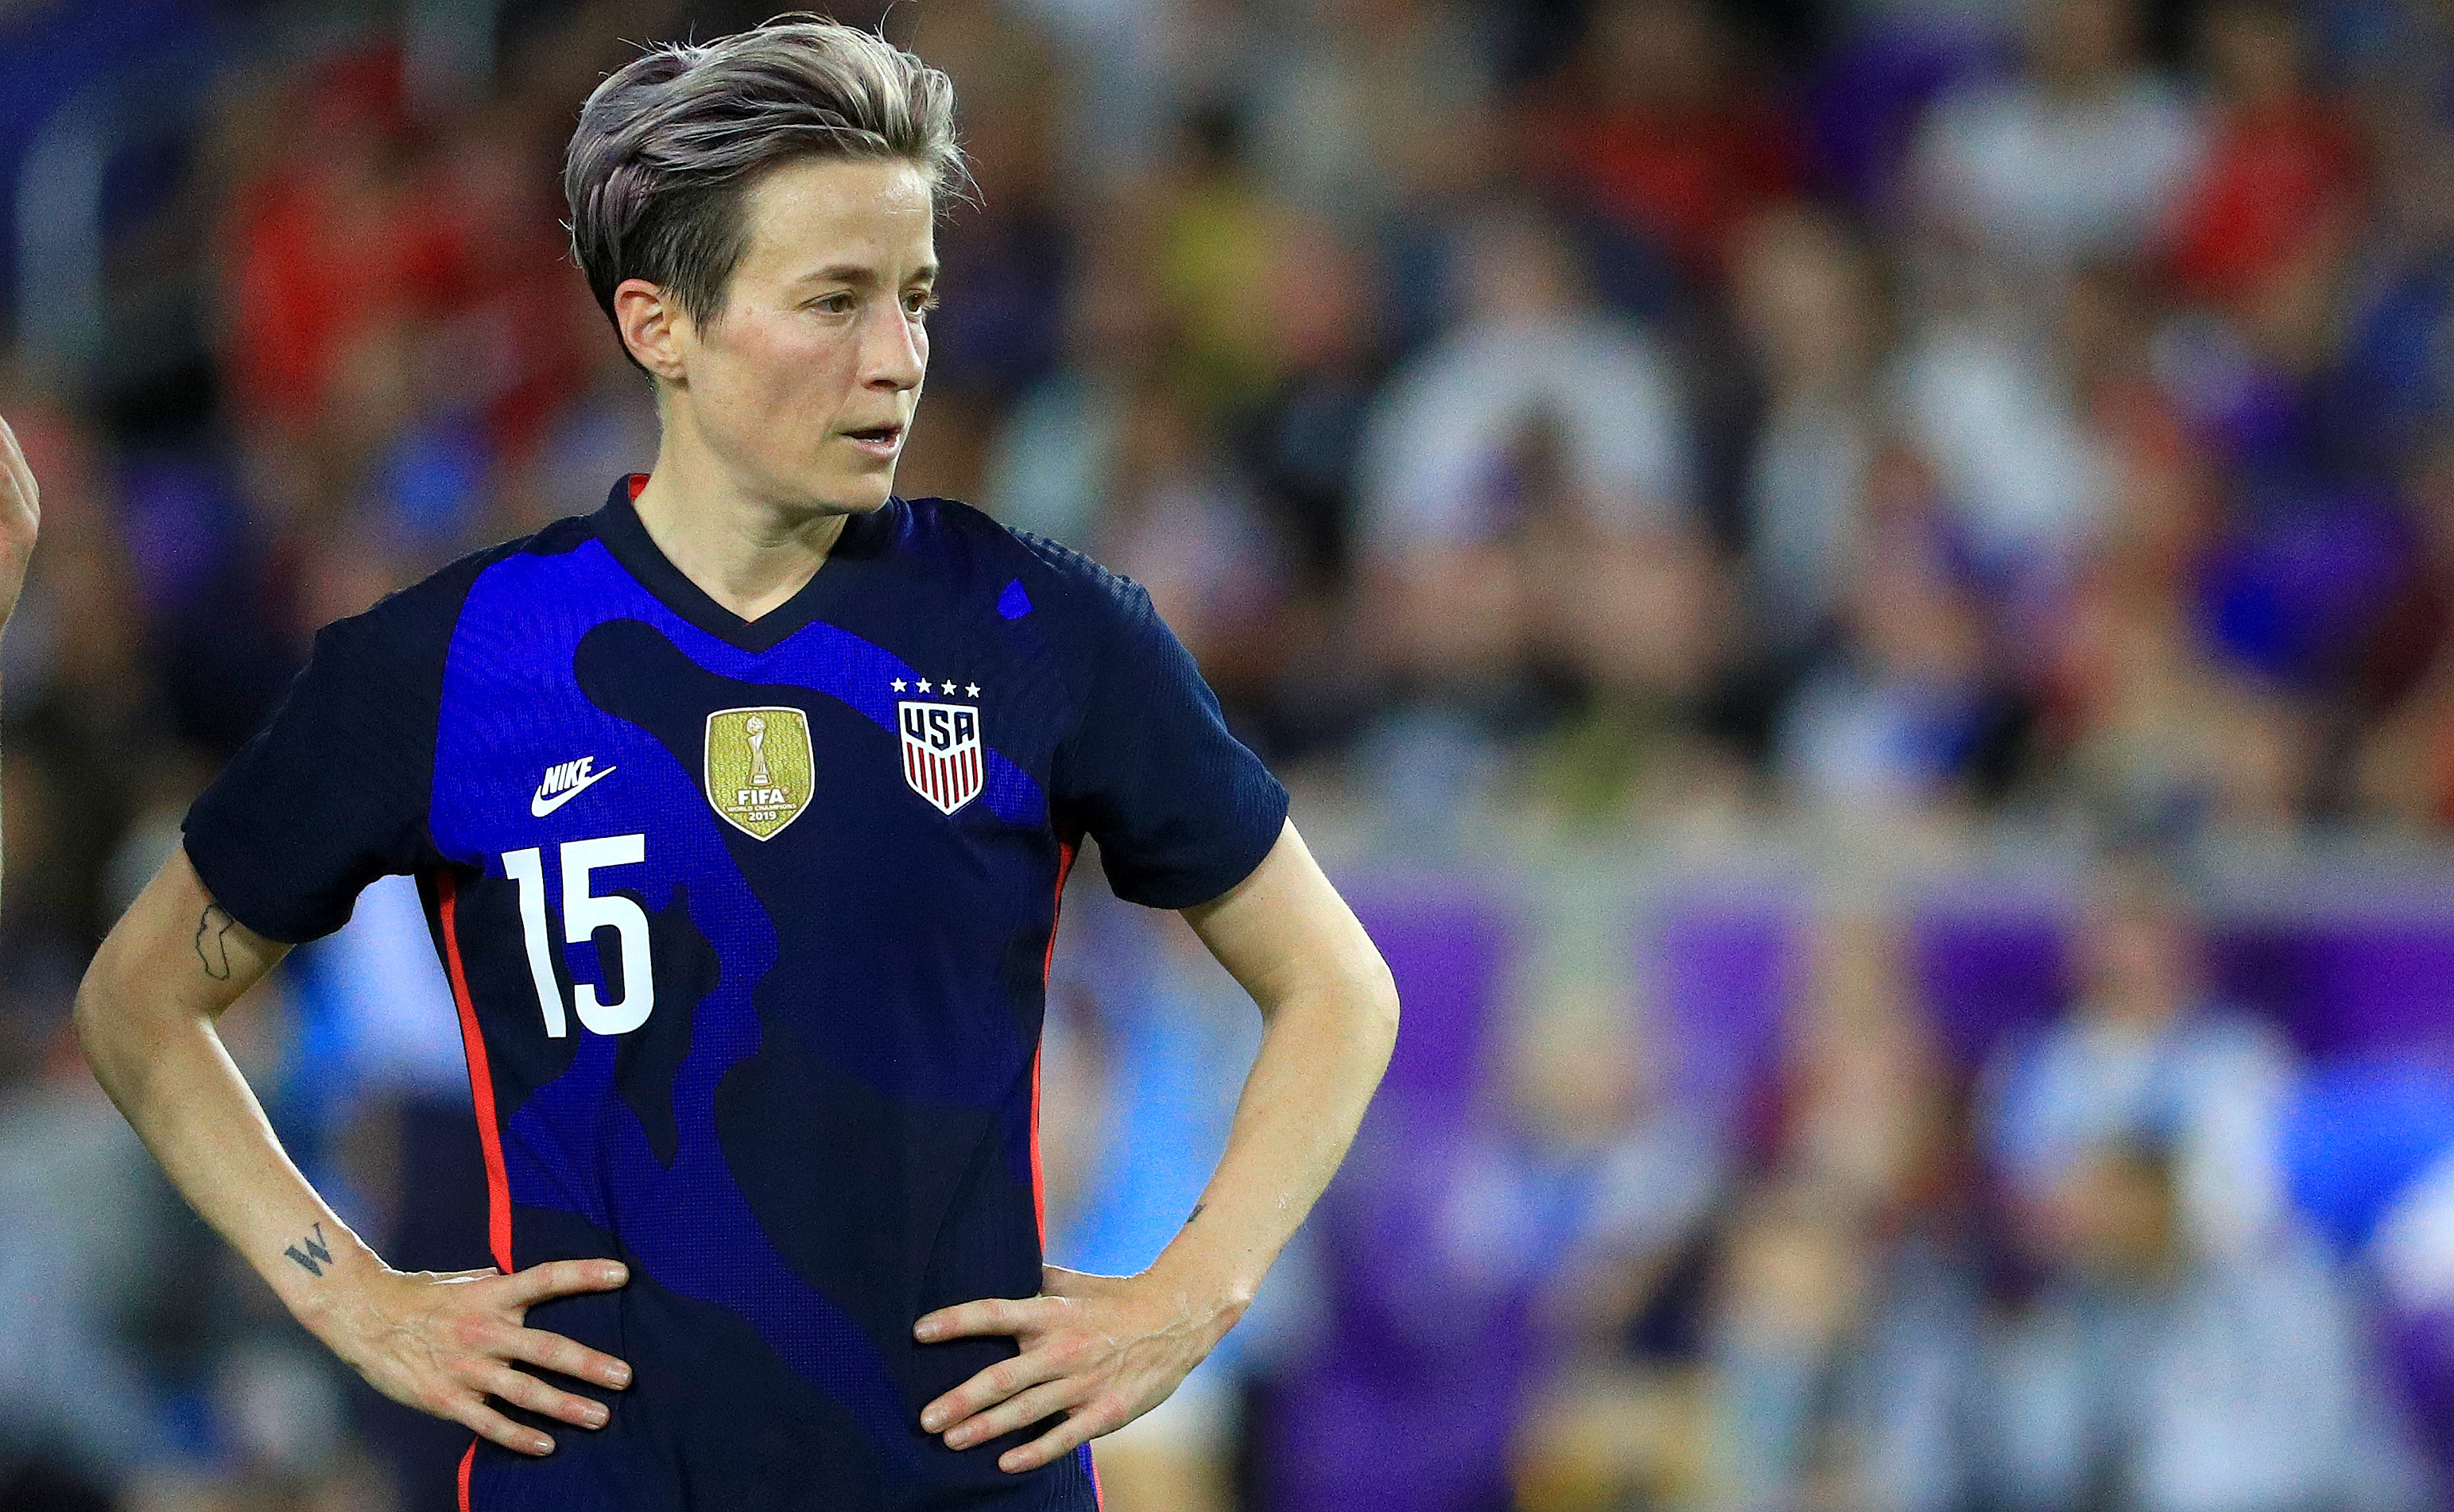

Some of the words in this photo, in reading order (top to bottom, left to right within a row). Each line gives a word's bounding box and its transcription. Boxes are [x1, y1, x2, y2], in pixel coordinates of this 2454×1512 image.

[904, 708, 975, 750] USA
[541, 755, 594, 796] NIKE
[738, 789, 785, 805] FIFA
[749, 811, 777, 821] 2019
[501, 833, 654, 1037] 15
[285, 1222, 332, 1277] W
